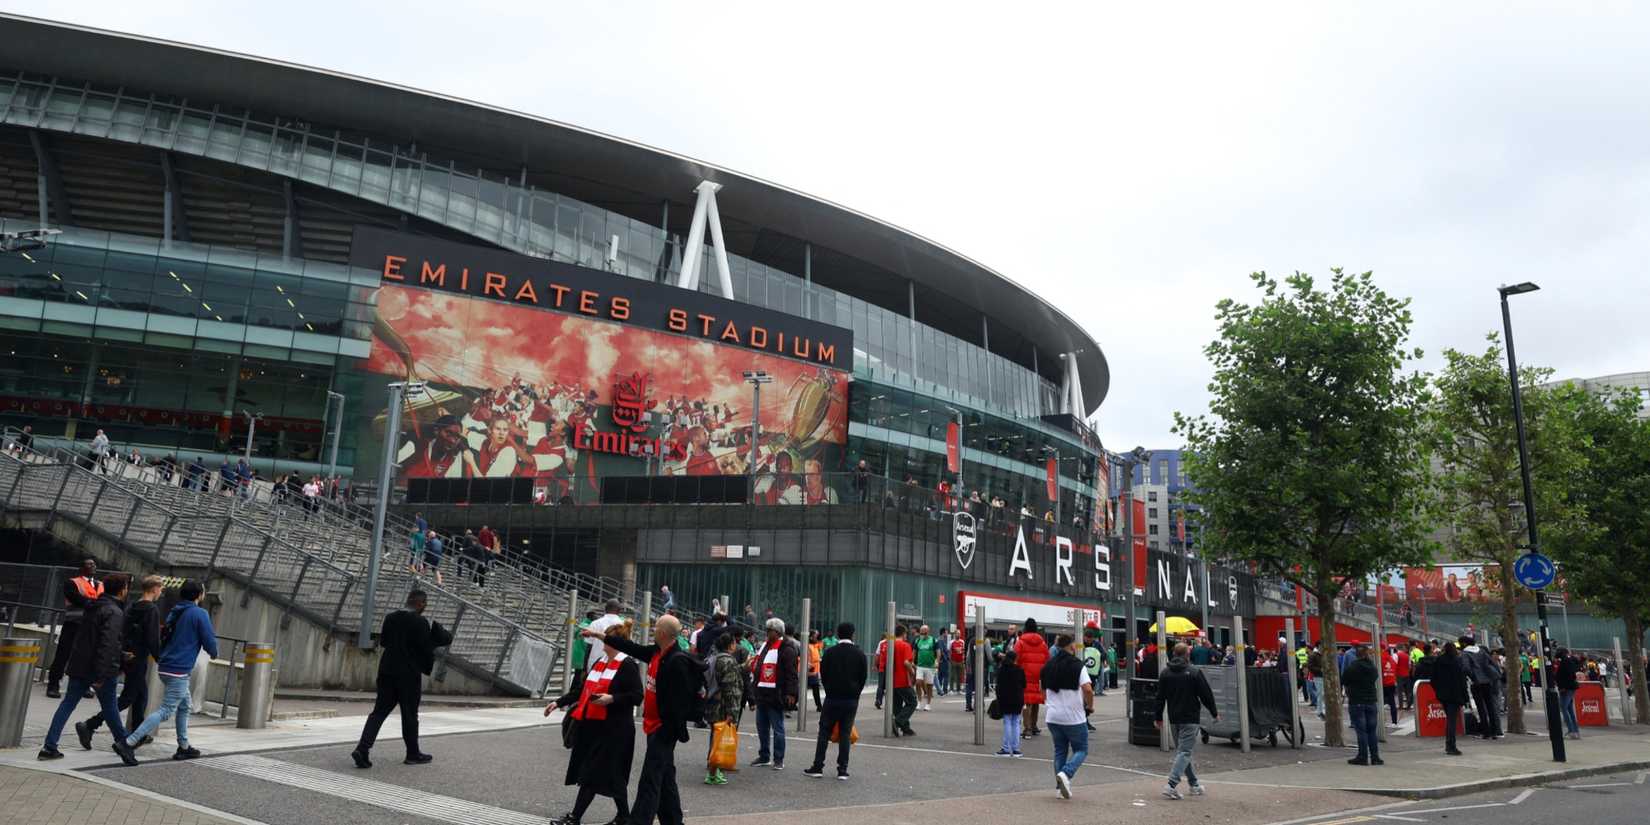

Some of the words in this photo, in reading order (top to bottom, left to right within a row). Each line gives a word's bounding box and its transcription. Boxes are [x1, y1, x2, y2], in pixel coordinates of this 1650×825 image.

[383, 255, 630, 320] EMIRATES
[668, 308, 835, 364] STADIUM
[1009, 525, 1216, 608] ARSNAL
